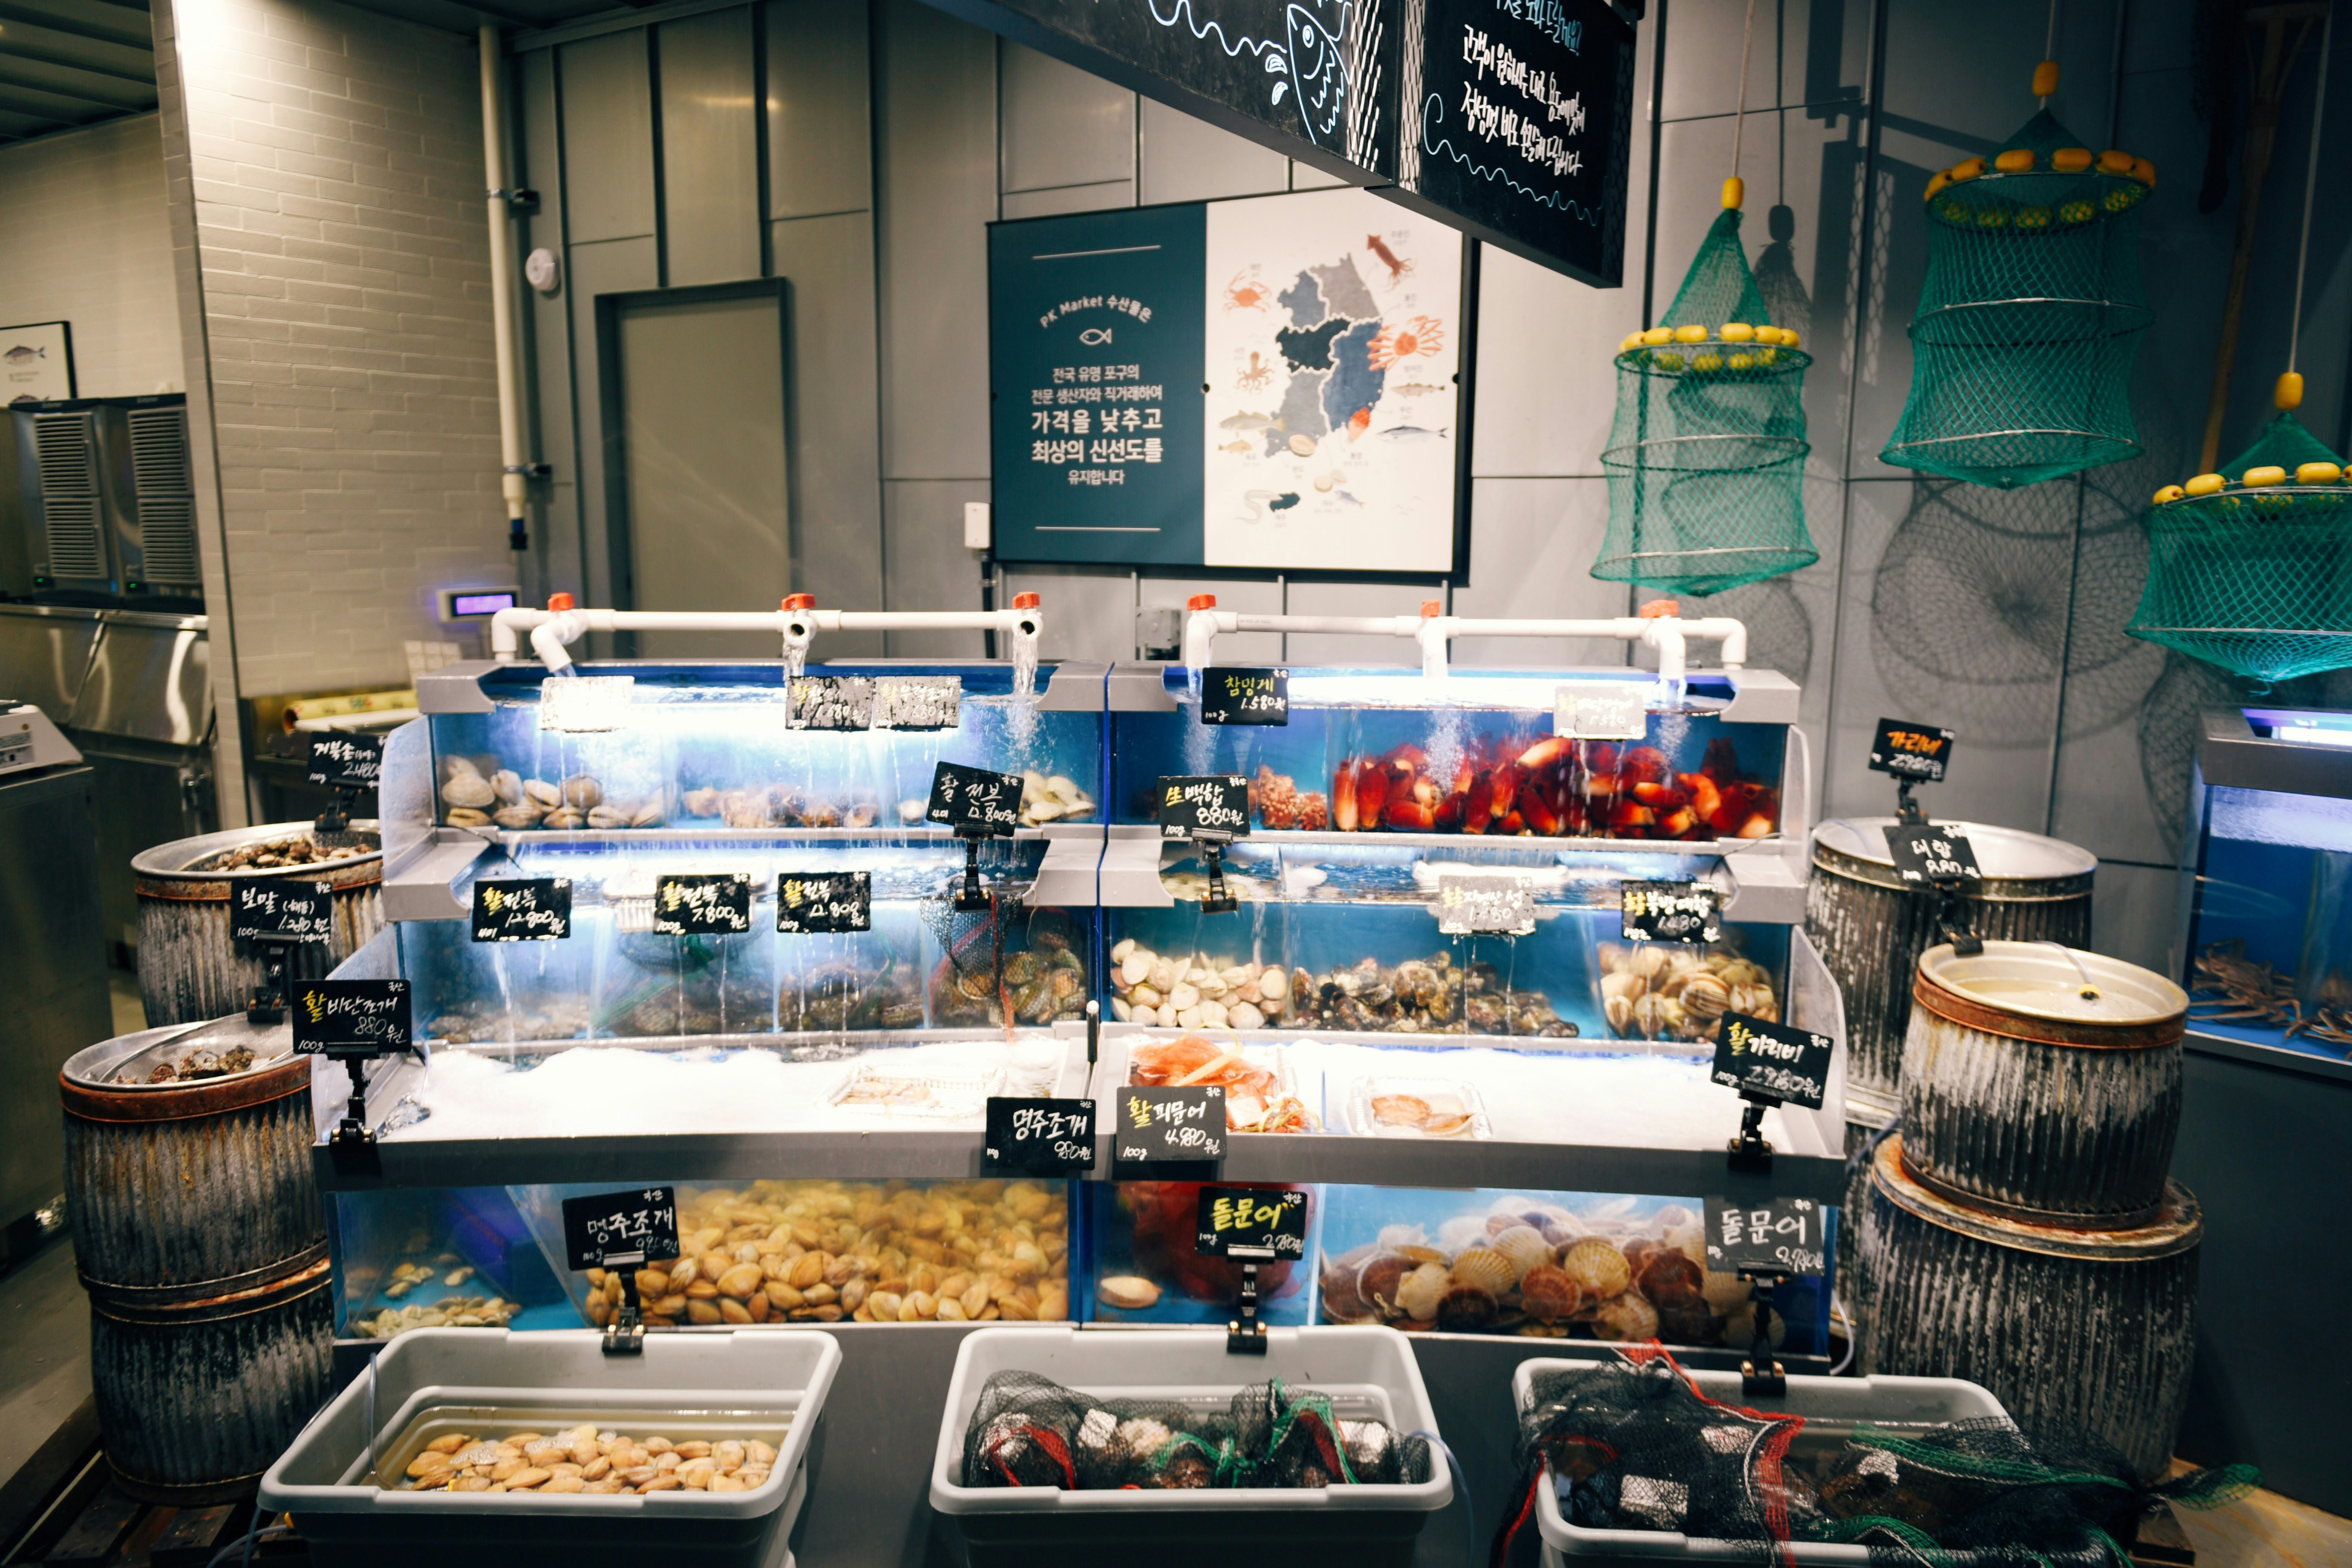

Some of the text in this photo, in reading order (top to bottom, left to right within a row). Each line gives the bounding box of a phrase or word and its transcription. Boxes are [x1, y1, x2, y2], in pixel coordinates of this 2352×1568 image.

[1463, 24, 1494, 80] 고객이
[1460, 81, 1499, 143] 정성껏
[1040, 295, 1152, 329] PK Market 수산물은
[1052, 364, 1140, 383] 전국 유명 포구의
[1031, 384, 1162, 404] 전문 생산자와 직거래하여
[1032, 407, 1163, 434] 가격을 낮추고
[1032, 438, 1164, 464] 최상의 신선도를
[1068, 469, 1125, 485] 유지합니다
[899, 684, 954, 702] 우럭조개
[314, 740, 355, 761] 거북손
[309, 772, 327, 785] 100g
[940, 772, 1003, 809] 활 전복
[1165, 824, 1186, 837] 100g
[315, 881, 331, 894] 국산
[242, 886, 280, 915] 보말
[657, 920, 681, 934] 100g
[779, 920, 799, 932] 100g
[388, 981, 405, 992] 국산
[327, 995, 398, 1016] 비단조개
[298, 1039, 325, 1053] 100g
[1715, 1070, 1740, 1087] 100g
[1205, 1087, 1221, 1098] 국산
[1152, 1100, 1207, 1126] 피문어
[1012, 1108, 1088, 1141] 명주조개
[986, 1147, 1000, 1159] 100g
[1123, 1146, 1148, 1161] 100g
[1211, 1197, 1282, 1232] 돌문어
[1721, 1208, 1806, 1246] 돌문어
[1199, 1232, 1218, 1246] 100g
